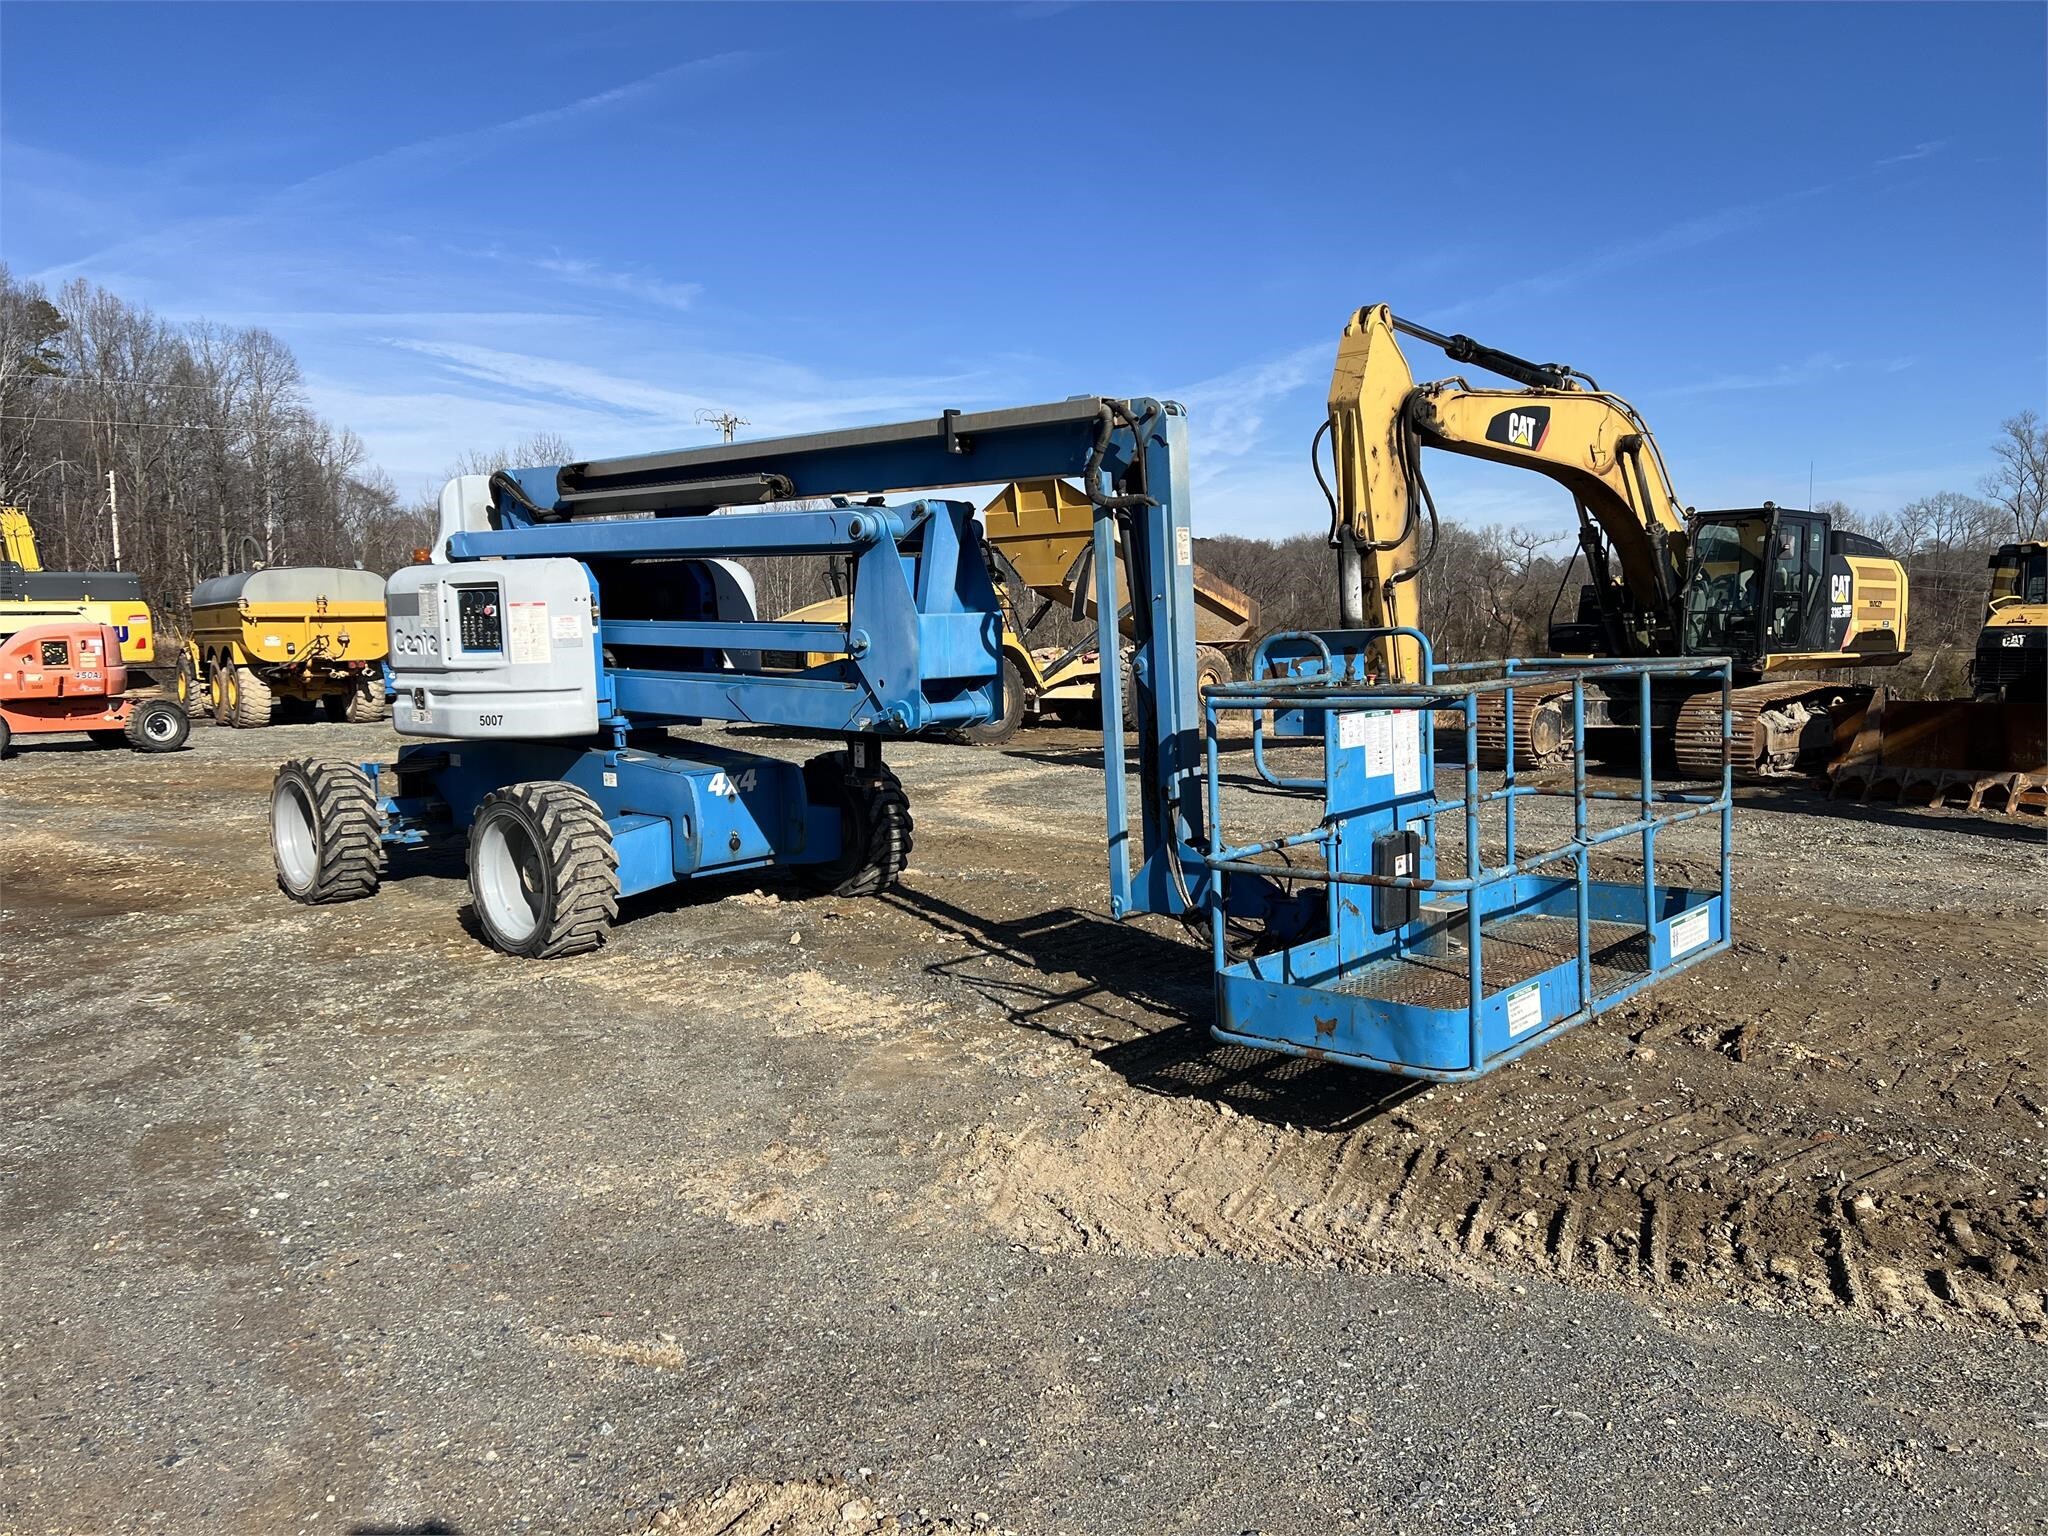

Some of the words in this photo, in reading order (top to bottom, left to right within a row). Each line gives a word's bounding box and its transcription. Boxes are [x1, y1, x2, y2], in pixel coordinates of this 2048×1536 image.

[1508, 412, 1536, 447] CAT
[1831, 574, 1851, 603] CAT
[394, 628, 438, 655] Genie
[2002, 634, 2026, 647] CAT
[479, 715, 503, 726] 5007
[707, 768, 757, 797] 4x4
